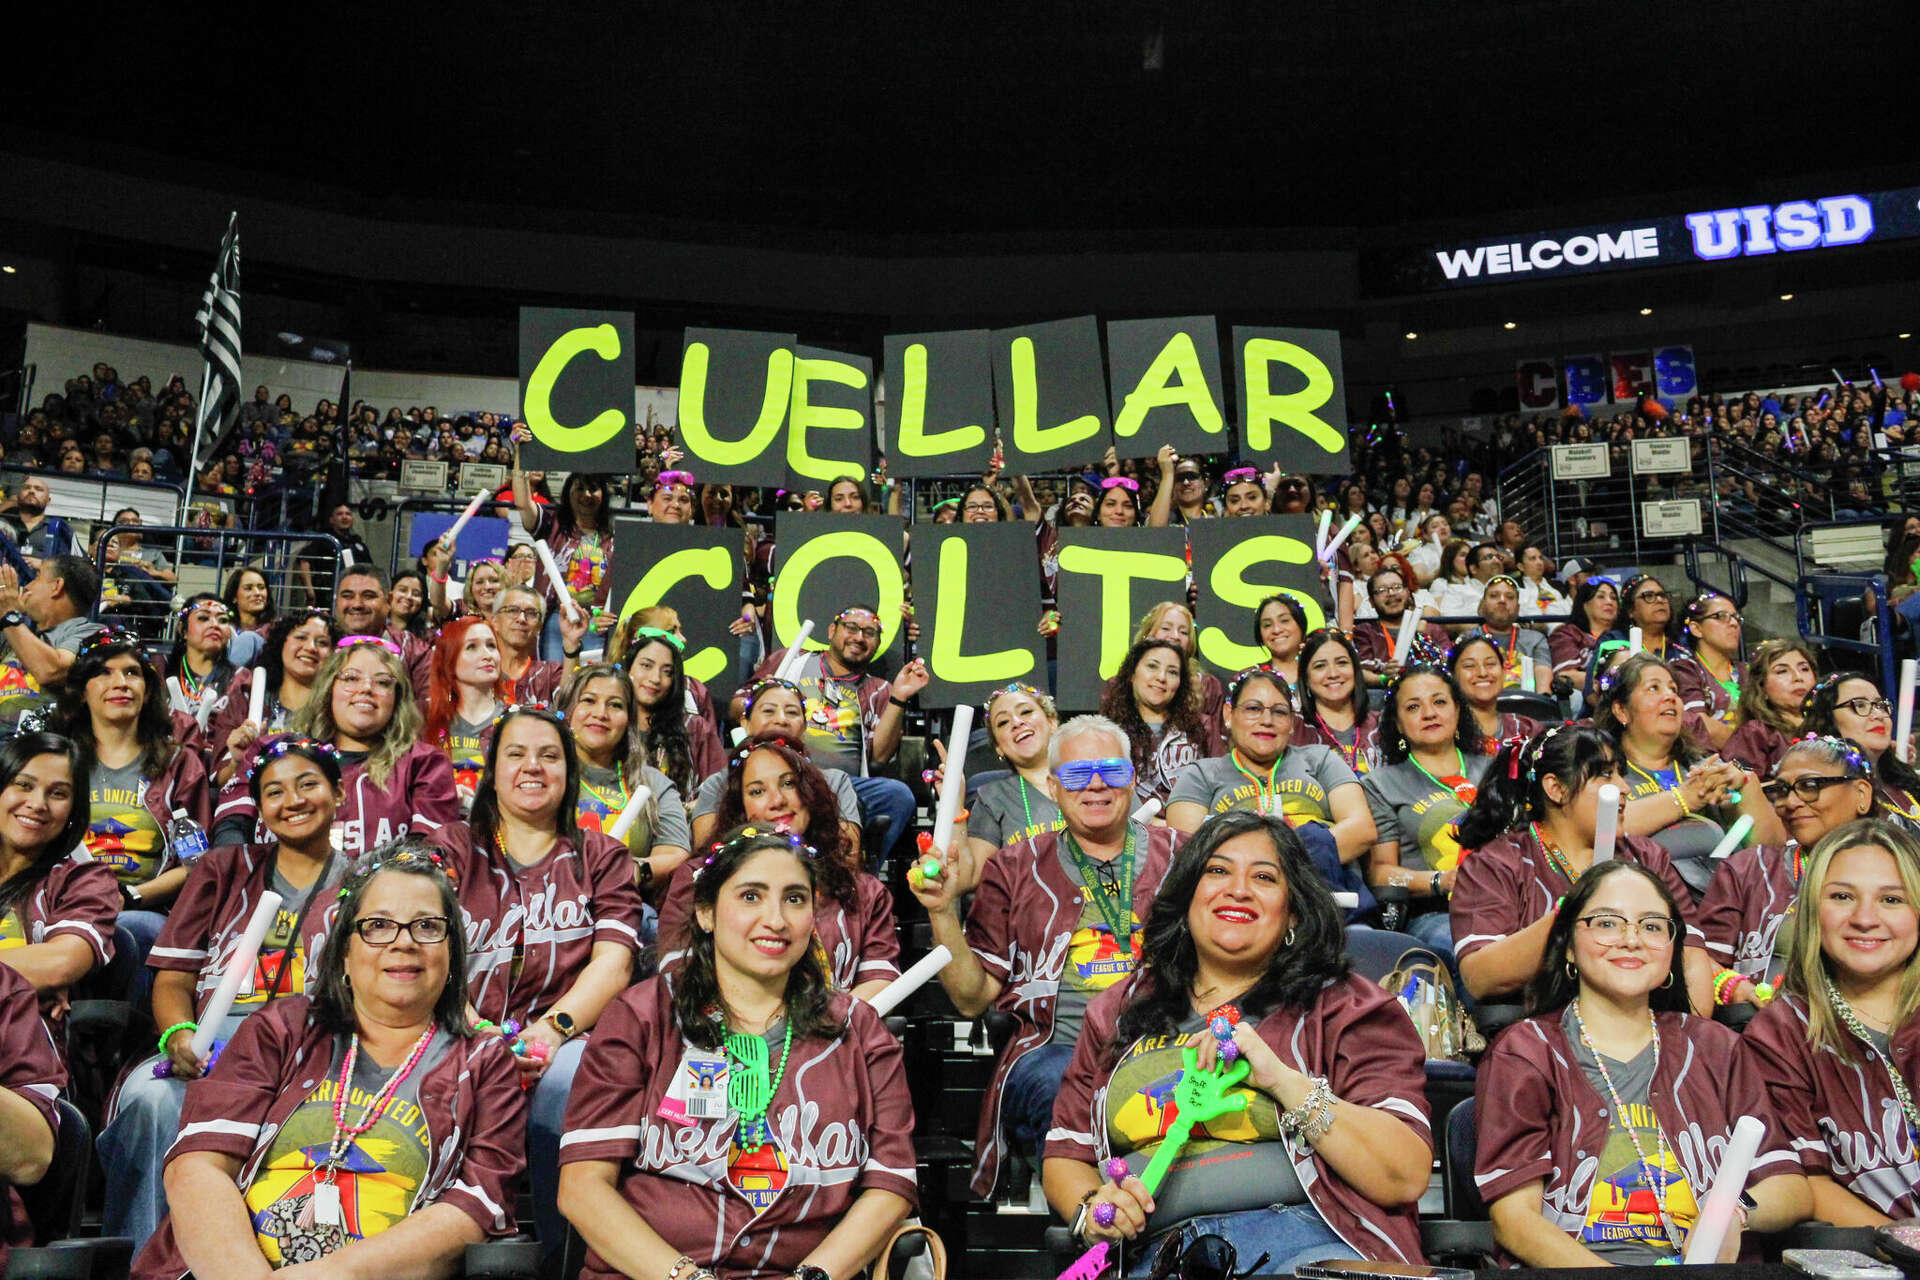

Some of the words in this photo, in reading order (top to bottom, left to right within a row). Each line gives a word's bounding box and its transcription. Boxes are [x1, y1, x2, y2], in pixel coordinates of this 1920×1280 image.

[1437, 227, 1659, 280] WELCOME
[1686, 195, 1875, 260] UISD
[524, 323, 1345, 481] CUELLAR
[1518, 347, 1697, 408] CBES
[619, 531, 1325, 684] COLTS
[104, 788, 144, 808] UNITE
[1215, 794, 1234, 813] WE
[1233, 785, 1258, 801] ARE
